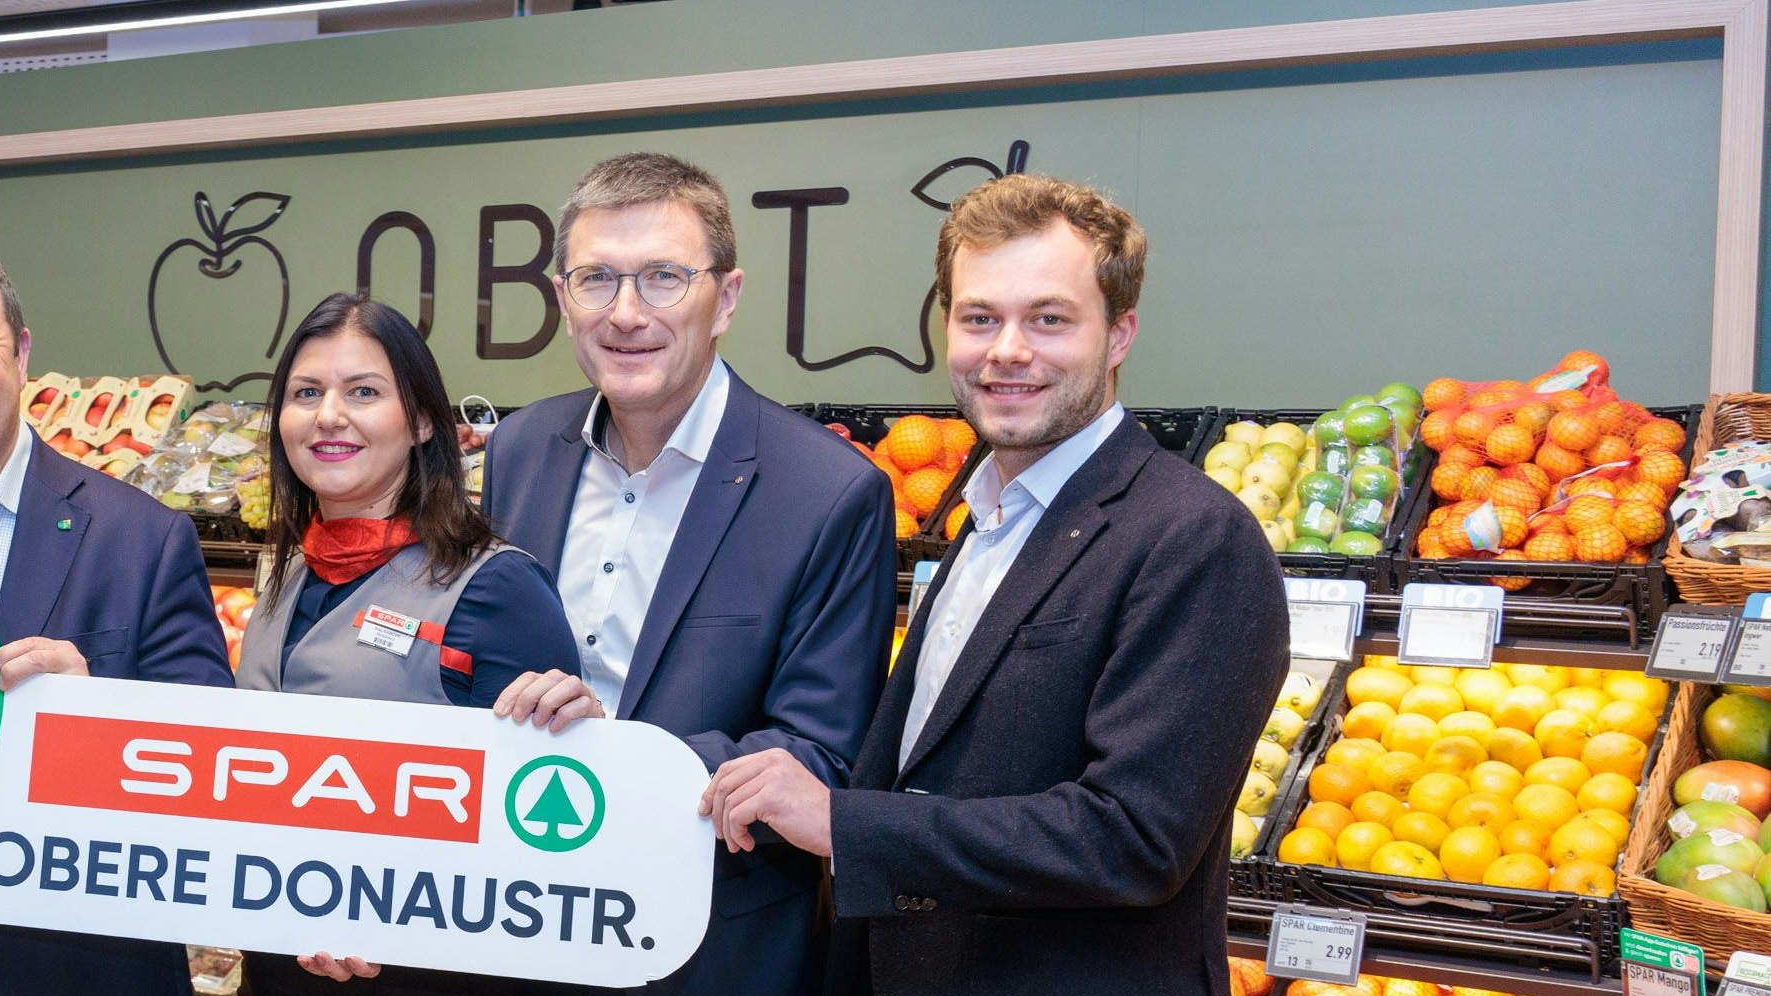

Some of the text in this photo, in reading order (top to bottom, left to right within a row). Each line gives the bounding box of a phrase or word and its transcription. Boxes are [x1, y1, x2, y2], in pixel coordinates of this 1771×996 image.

[357, 187, 849, 360] OBT
[377, 611, 405, 627] SPAR
[1668, 618, 1727, 632] Passionsfrüchte
[1698, 642, 1722, 657] 2.19
[121, 738, 473, 824] SPAR
[232, 857, 656, 950] DONAUSTR.
[1282, 918, 1355, 936] SPAR Clementine
[1326, 944, 1352, 960] 2.99
[1288, 956, 1298, 967] 13
[1629, 965, 1690, 993] SPAR Mango
